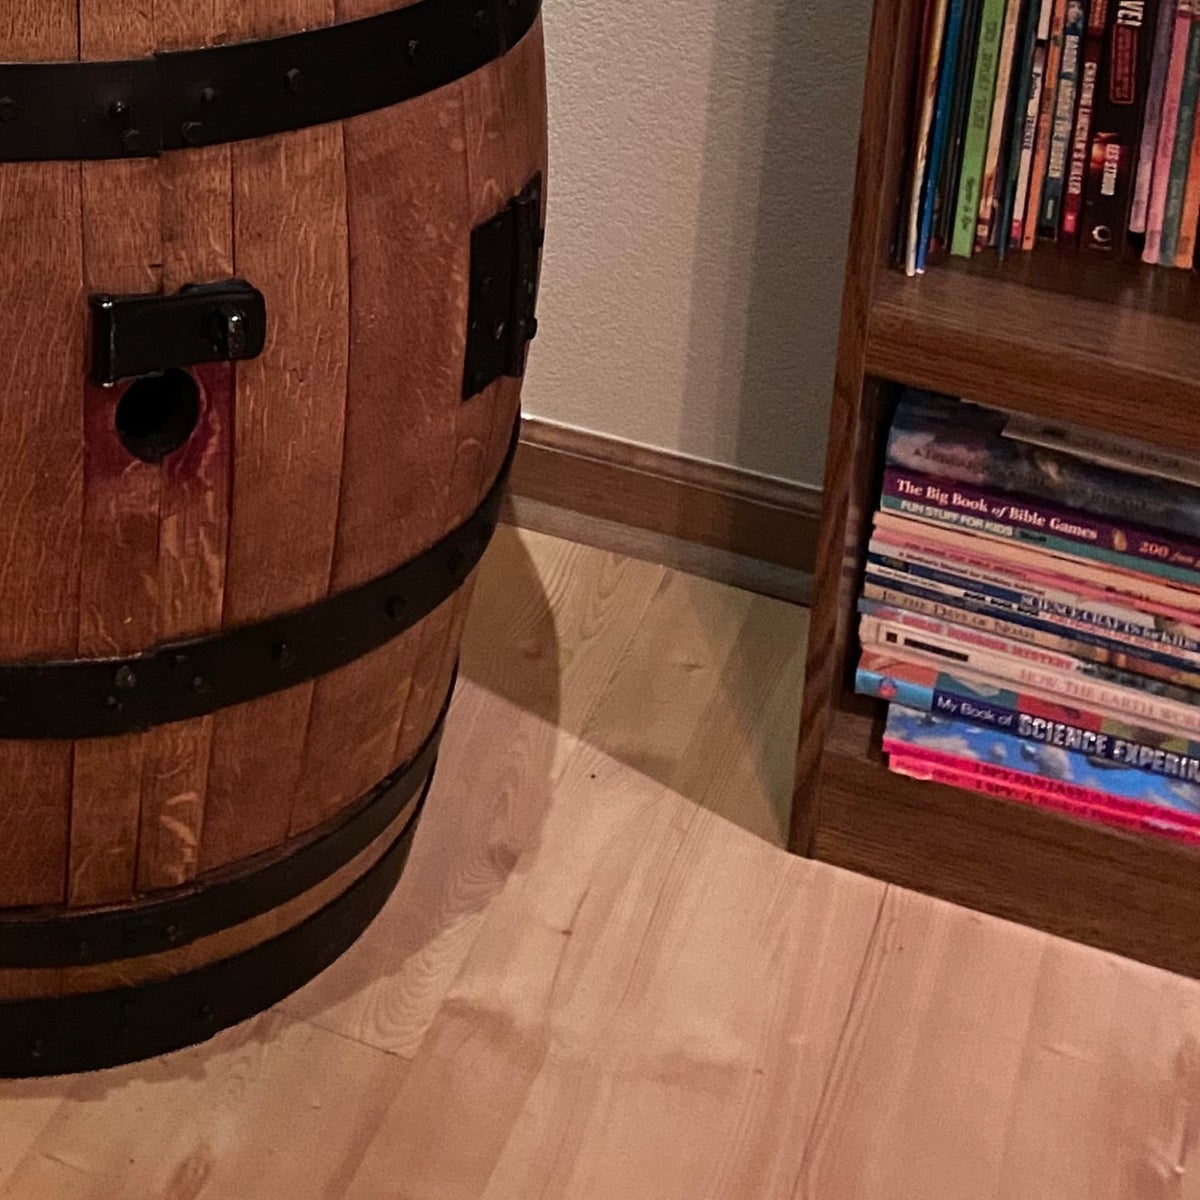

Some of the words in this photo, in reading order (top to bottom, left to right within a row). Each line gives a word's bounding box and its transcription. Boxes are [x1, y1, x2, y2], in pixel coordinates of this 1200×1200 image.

[895, 476, 925, 497] The
[925, 484, 951, 507] Big
[952, 491, 989, 513] Book
[990, 502, 1008, 519] of
[1008, 505, 1046, 527] Bible
[1047, 516, 1099, 541] Games
[1138, 539, 1169, 557] 200
[900, 499, 924, 514] FUN
[923, 505, 959, 522] STUFF
[959, 513, 984, 529] FOR
[984, 519, 1014, 536] KIDS
[935, 696, 957, 713] My
[959, 702, 995, 722] Book
[995, 711, 1014, 727] of
[1015, 713, 1110, 756] SCIENCE
